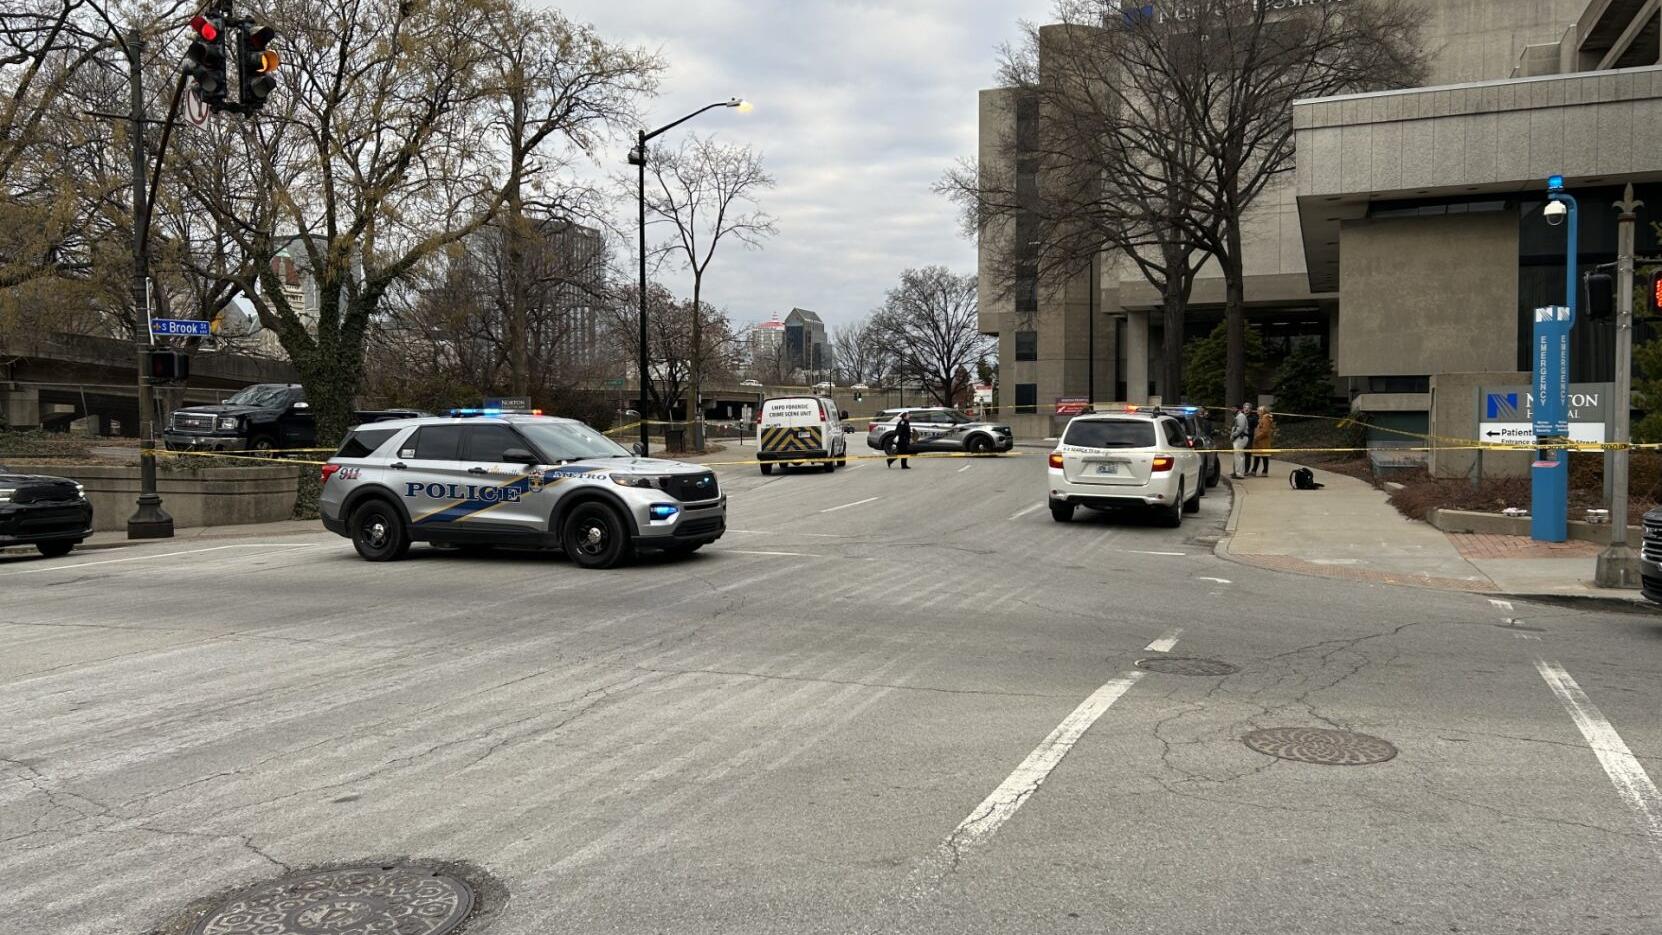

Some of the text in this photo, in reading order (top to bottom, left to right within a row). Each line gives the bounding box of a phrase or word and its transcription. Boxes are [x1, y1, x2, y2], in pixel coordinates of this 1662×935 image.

[161, 323, 167, 331] S
[169, 321, 198, 334] Brook
[339, 467, 362, 480] 911
[552, 470, 608, 481] METRO
[405, 482, 521, 503] POLICE
